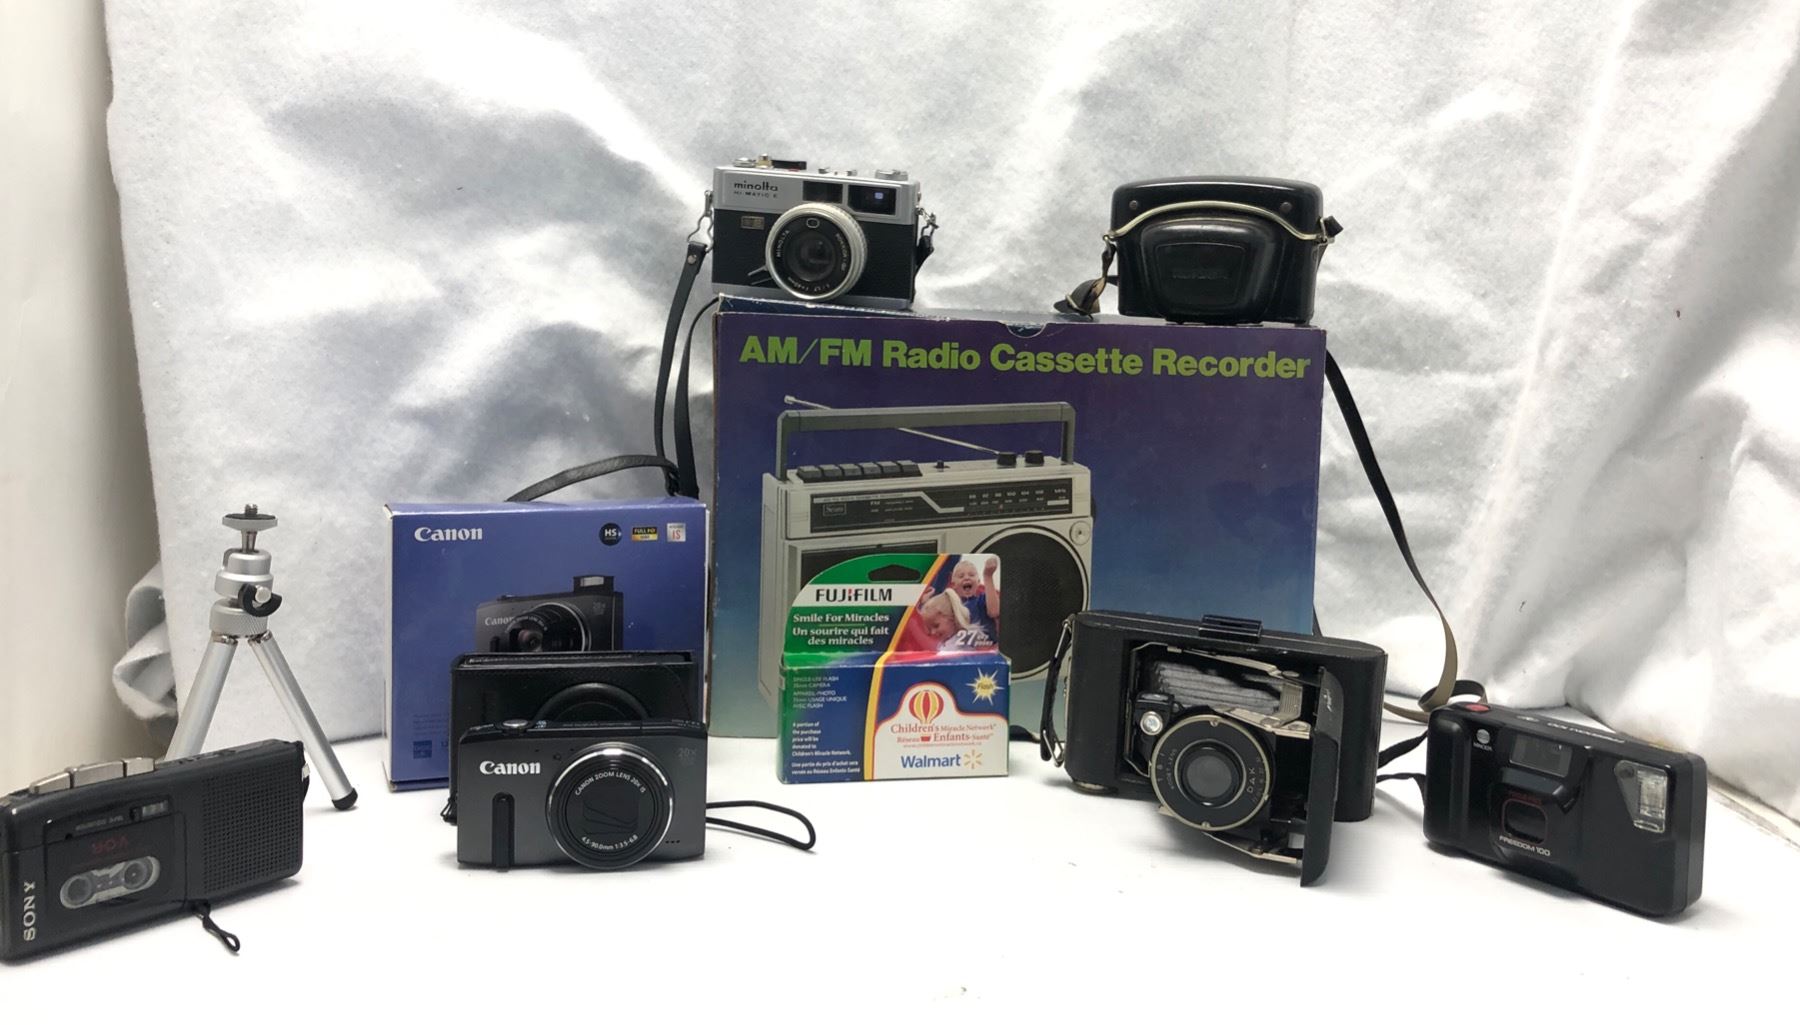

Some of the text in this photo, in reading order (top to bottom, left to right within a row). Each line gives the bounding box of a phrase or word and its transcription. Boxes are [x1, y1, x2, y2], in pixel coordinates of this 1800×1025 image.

[734, 180, 778, 192] minolta
[739, 336, 1311, 379] AM/FM Radio Cassette Recorder
[414, 526, 483, 542] Canon
[604, 528, 617, 537] HS
[672, 529, 682, 540] IS
[816, 588, 892, 602] FUJIFILM
[793, 613, 889, 622] Smile For Miracles
[792, 626, 889, 638] Un sourire qui fait
[956, 629, 978, 646] 27
[808, 636, 873, 645] des miracles
[890, 723, 939, 734] Children's
[479, 760, 541, 775] Canon
[900, 754, 961, 769] Walmart
[574, 776, 595, 796] CANON
[595, 771, 615, 780] ZOOM
[616, 771, 631, 781] LENS
[1499, 835, 1551, 857] FREEDOM 100
[23, 881, 36, 942] SONY
